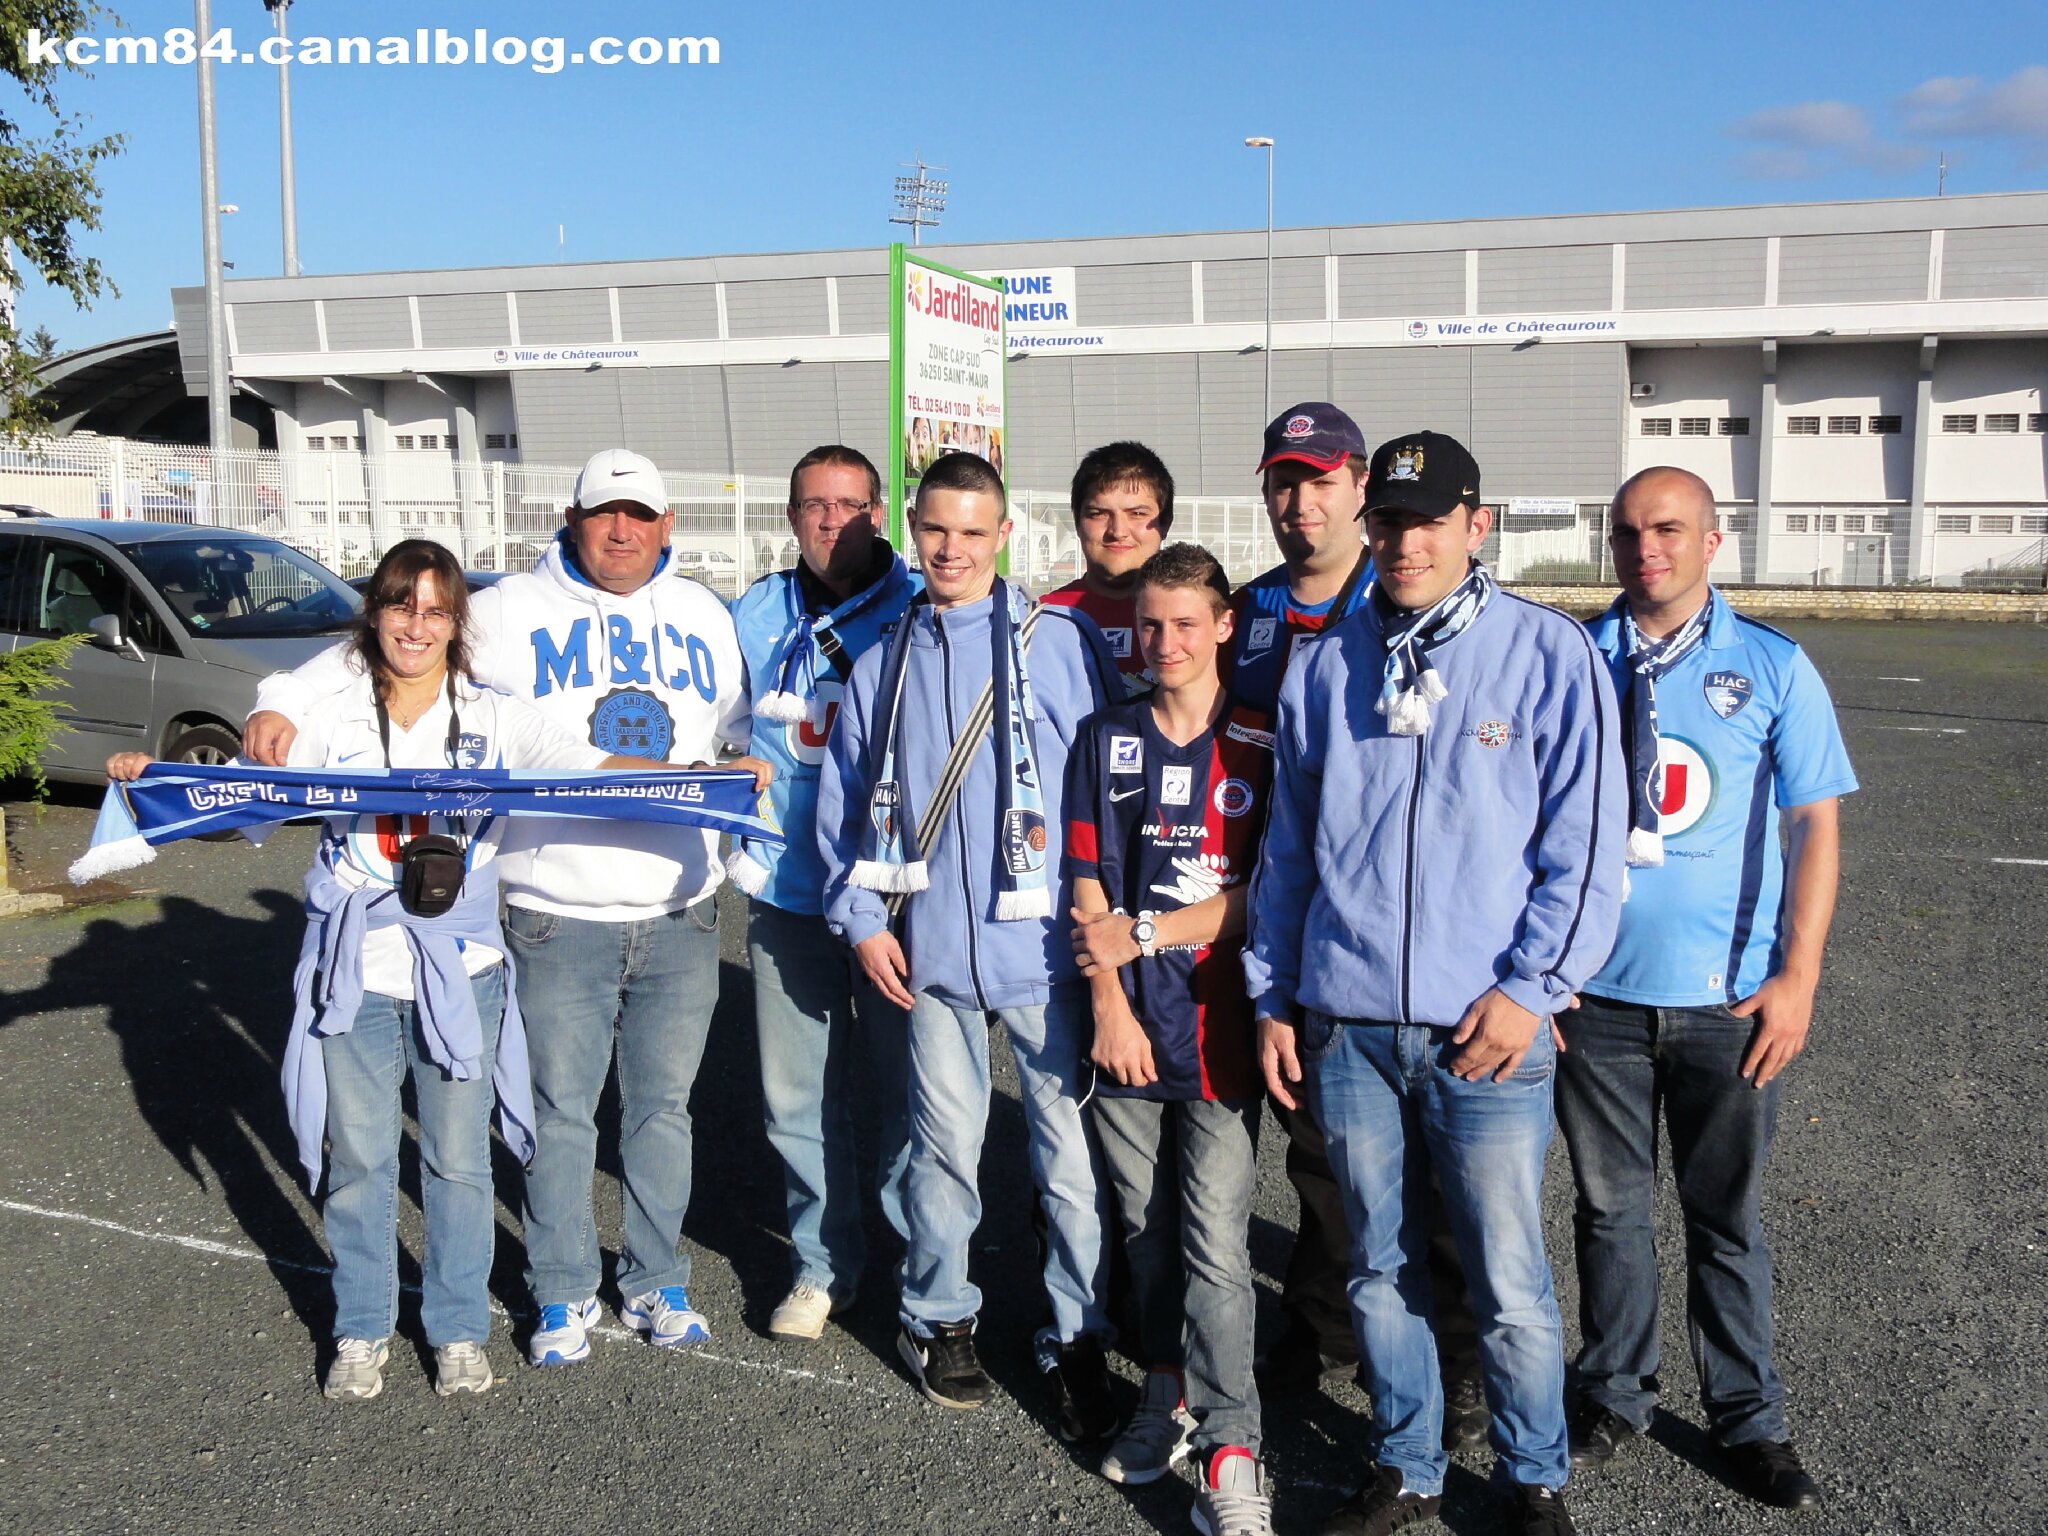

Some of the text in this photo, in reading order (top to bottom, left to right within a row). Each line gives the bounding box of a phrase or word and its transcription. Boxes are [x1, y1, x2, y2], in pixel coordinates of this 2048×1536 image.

[925, 276, 999, 332] Jardiland
[1437, 321, 1617, 335] Ville de Châteauroux
[514, 350, 639, 360] Ville de Châteauroux
[928, 343, 981, 368] ZONE CAP SUD
[919, 362, 989, 389] 36250 SAINT-MAUR
[925, 398, 934, 412] 02
[531, 614, 717, 704] M&CO
[1713, 675, 1746, 688] HAC
[599, 697, 667, 747] MARSHALL AND ORIGINAL
[1230, 725, 1276, 746] Intermarch
[1164, 767, 1191, 776] Région
[1162, 796, 1188, 804] Centre
[1012, 847, 1027, 870] HAC
